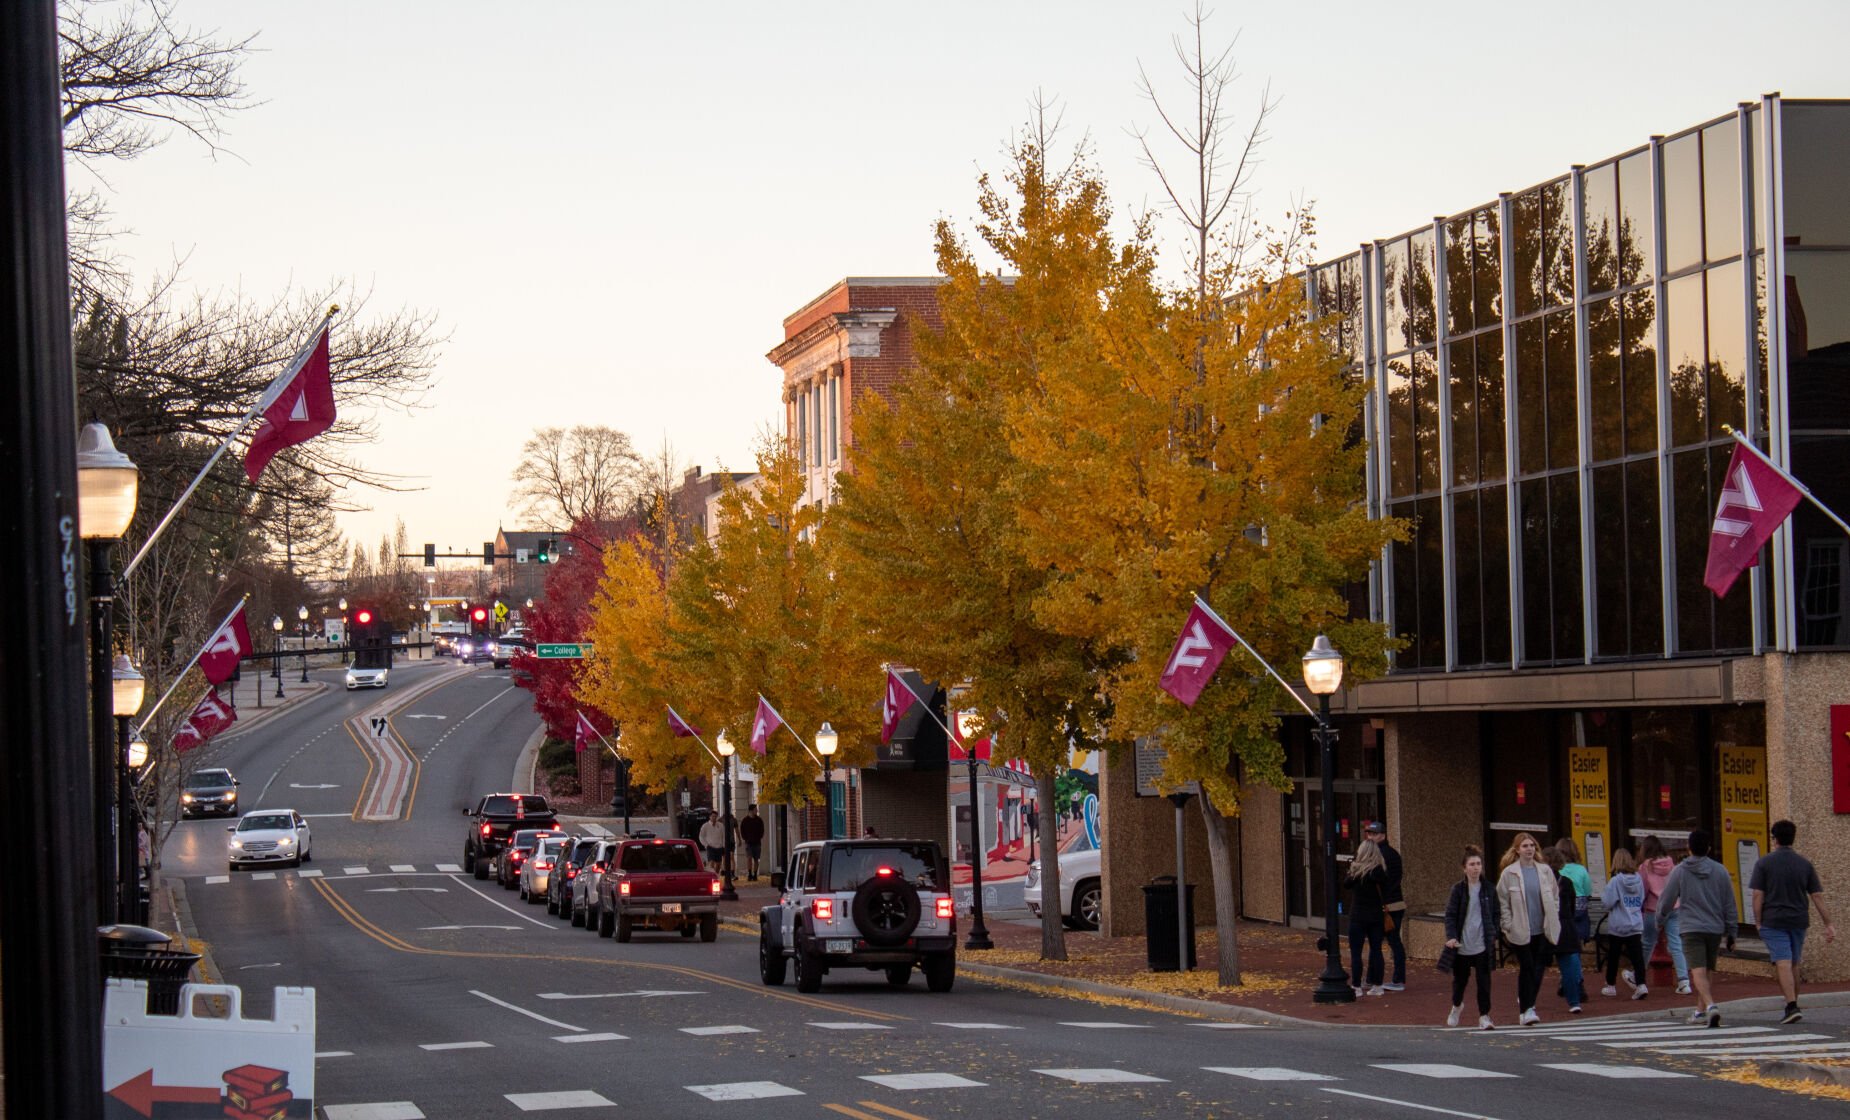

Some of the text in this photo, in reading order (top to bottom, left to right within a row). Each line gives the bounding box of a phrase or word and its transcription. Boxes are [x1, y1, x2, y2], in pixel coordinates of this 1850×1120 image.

[554, 646, 576, 656] College
[1572, 752, 1601, 773] Easier
[1723, 752, 1757, 775] Easier
[1572, 778, 1606, 800] is here!
[1723, 780, 1763, 805] is here!
